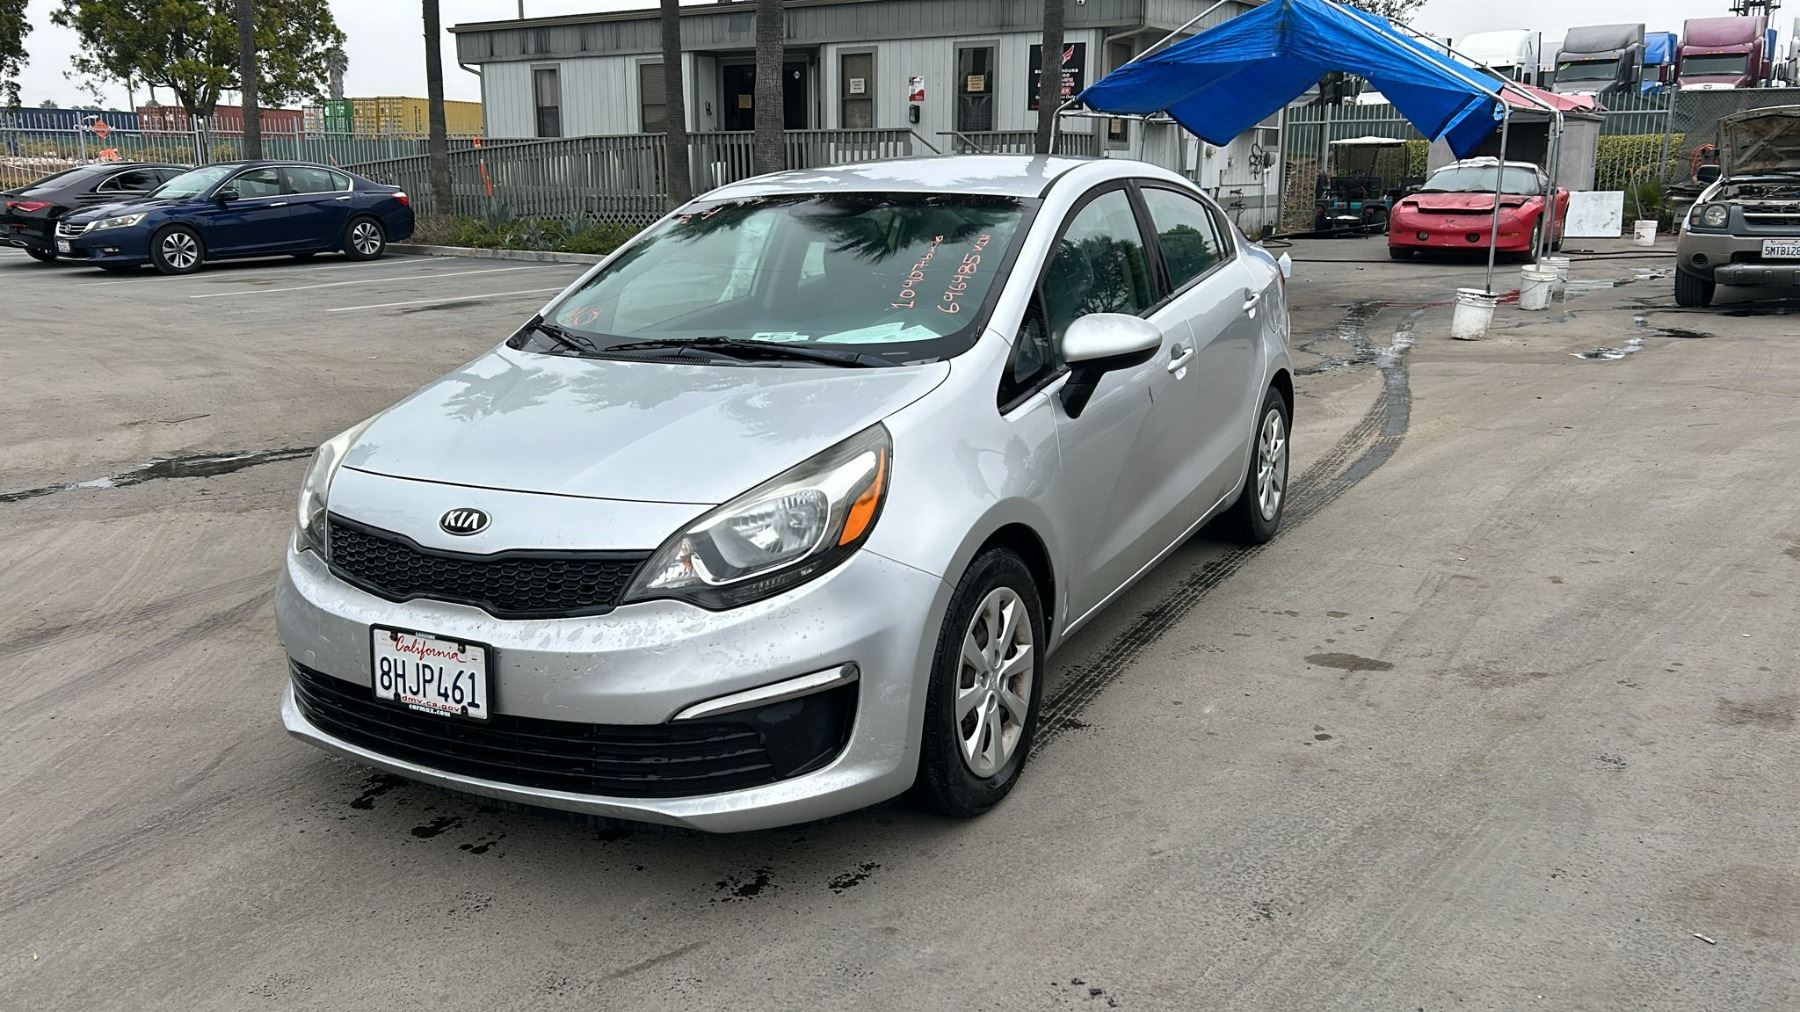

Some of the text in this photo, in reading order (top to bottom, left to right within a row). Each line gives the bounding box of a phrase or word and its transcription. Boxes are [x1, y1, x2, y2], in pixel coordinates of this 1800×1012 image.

[937, 253, 981, 314] 696485
[444, 510, 480, 529] KIA
[395, 635, 467, 664] California
[380, 656, 480, 709] 8HJP461
[401, 695, 460, 712] dmv.ca.gov
[408, 703, 450, 717] carmax.com
